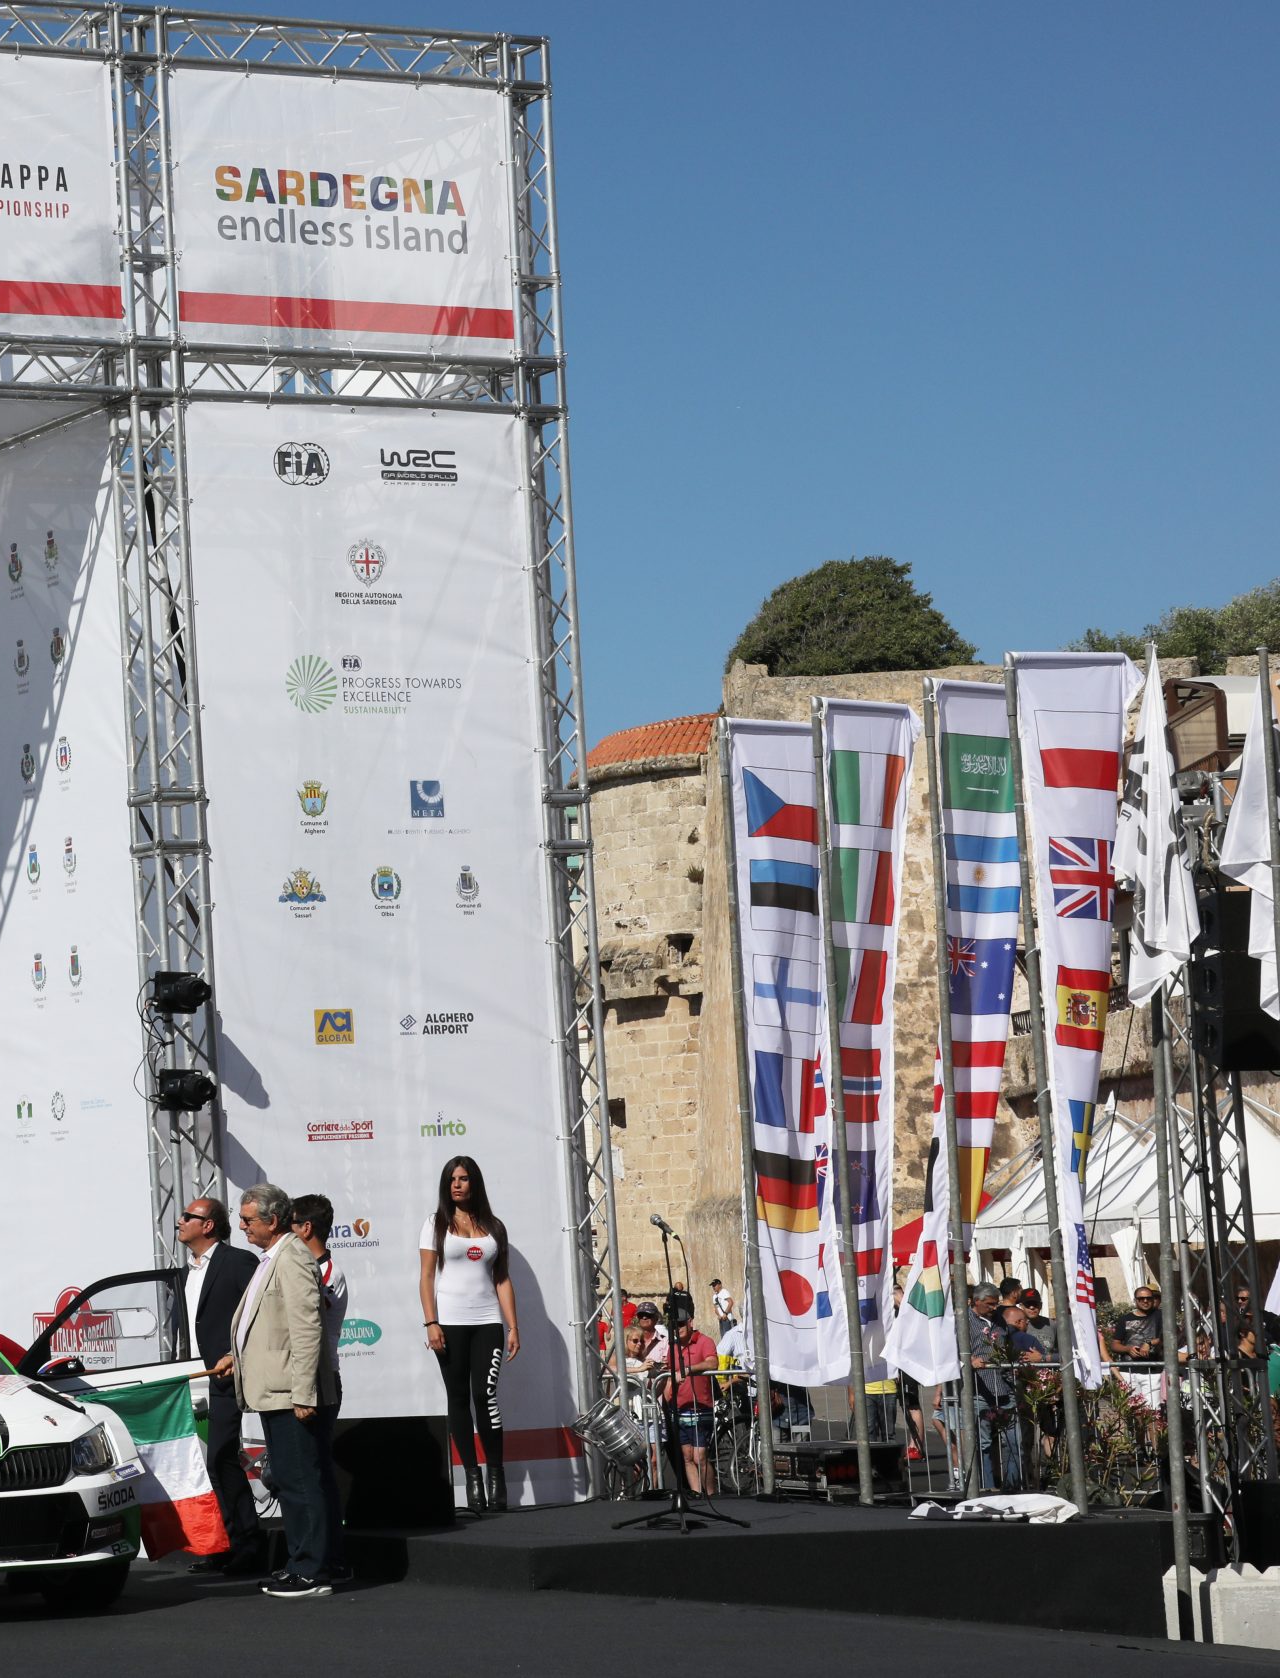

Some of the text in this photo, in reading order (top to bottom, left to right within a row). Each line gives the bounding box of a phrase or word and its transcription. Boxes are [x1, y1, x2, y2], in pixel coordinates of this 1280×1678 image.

[214, 165, 466, 217] SARDEGNA
[218, 208, 469, 254] endless island
[380, 448, 457, 468] WRC
[397, 472, 427, 480] WORLD
[428, 473, 456, 481] RALLY
[364, 592, 403, 600] AUTONOMA
[342, 677, 462, 690] PROGRESS TOWARDS
[343, 691, 412, 702] EXCELLENCE
[343, 705, 407, 714] SUSTAINABILITY
[412, 809, 444, 818] META
[304, 828, 326, 836] Alghero
[425, 1012, 474, 1024] ALGHERO
[422, 1024, 469, 1035] AIRPORT
[317, 1034, 353, 1043] GLOBAL
[307, 1121, 339, 1133] Corriere
[350, 1120, 373, 1133] Sport
[332, 1239, 380, 1249] assicurazioni
[98, 1486, 135, 1511] ŠKODA
